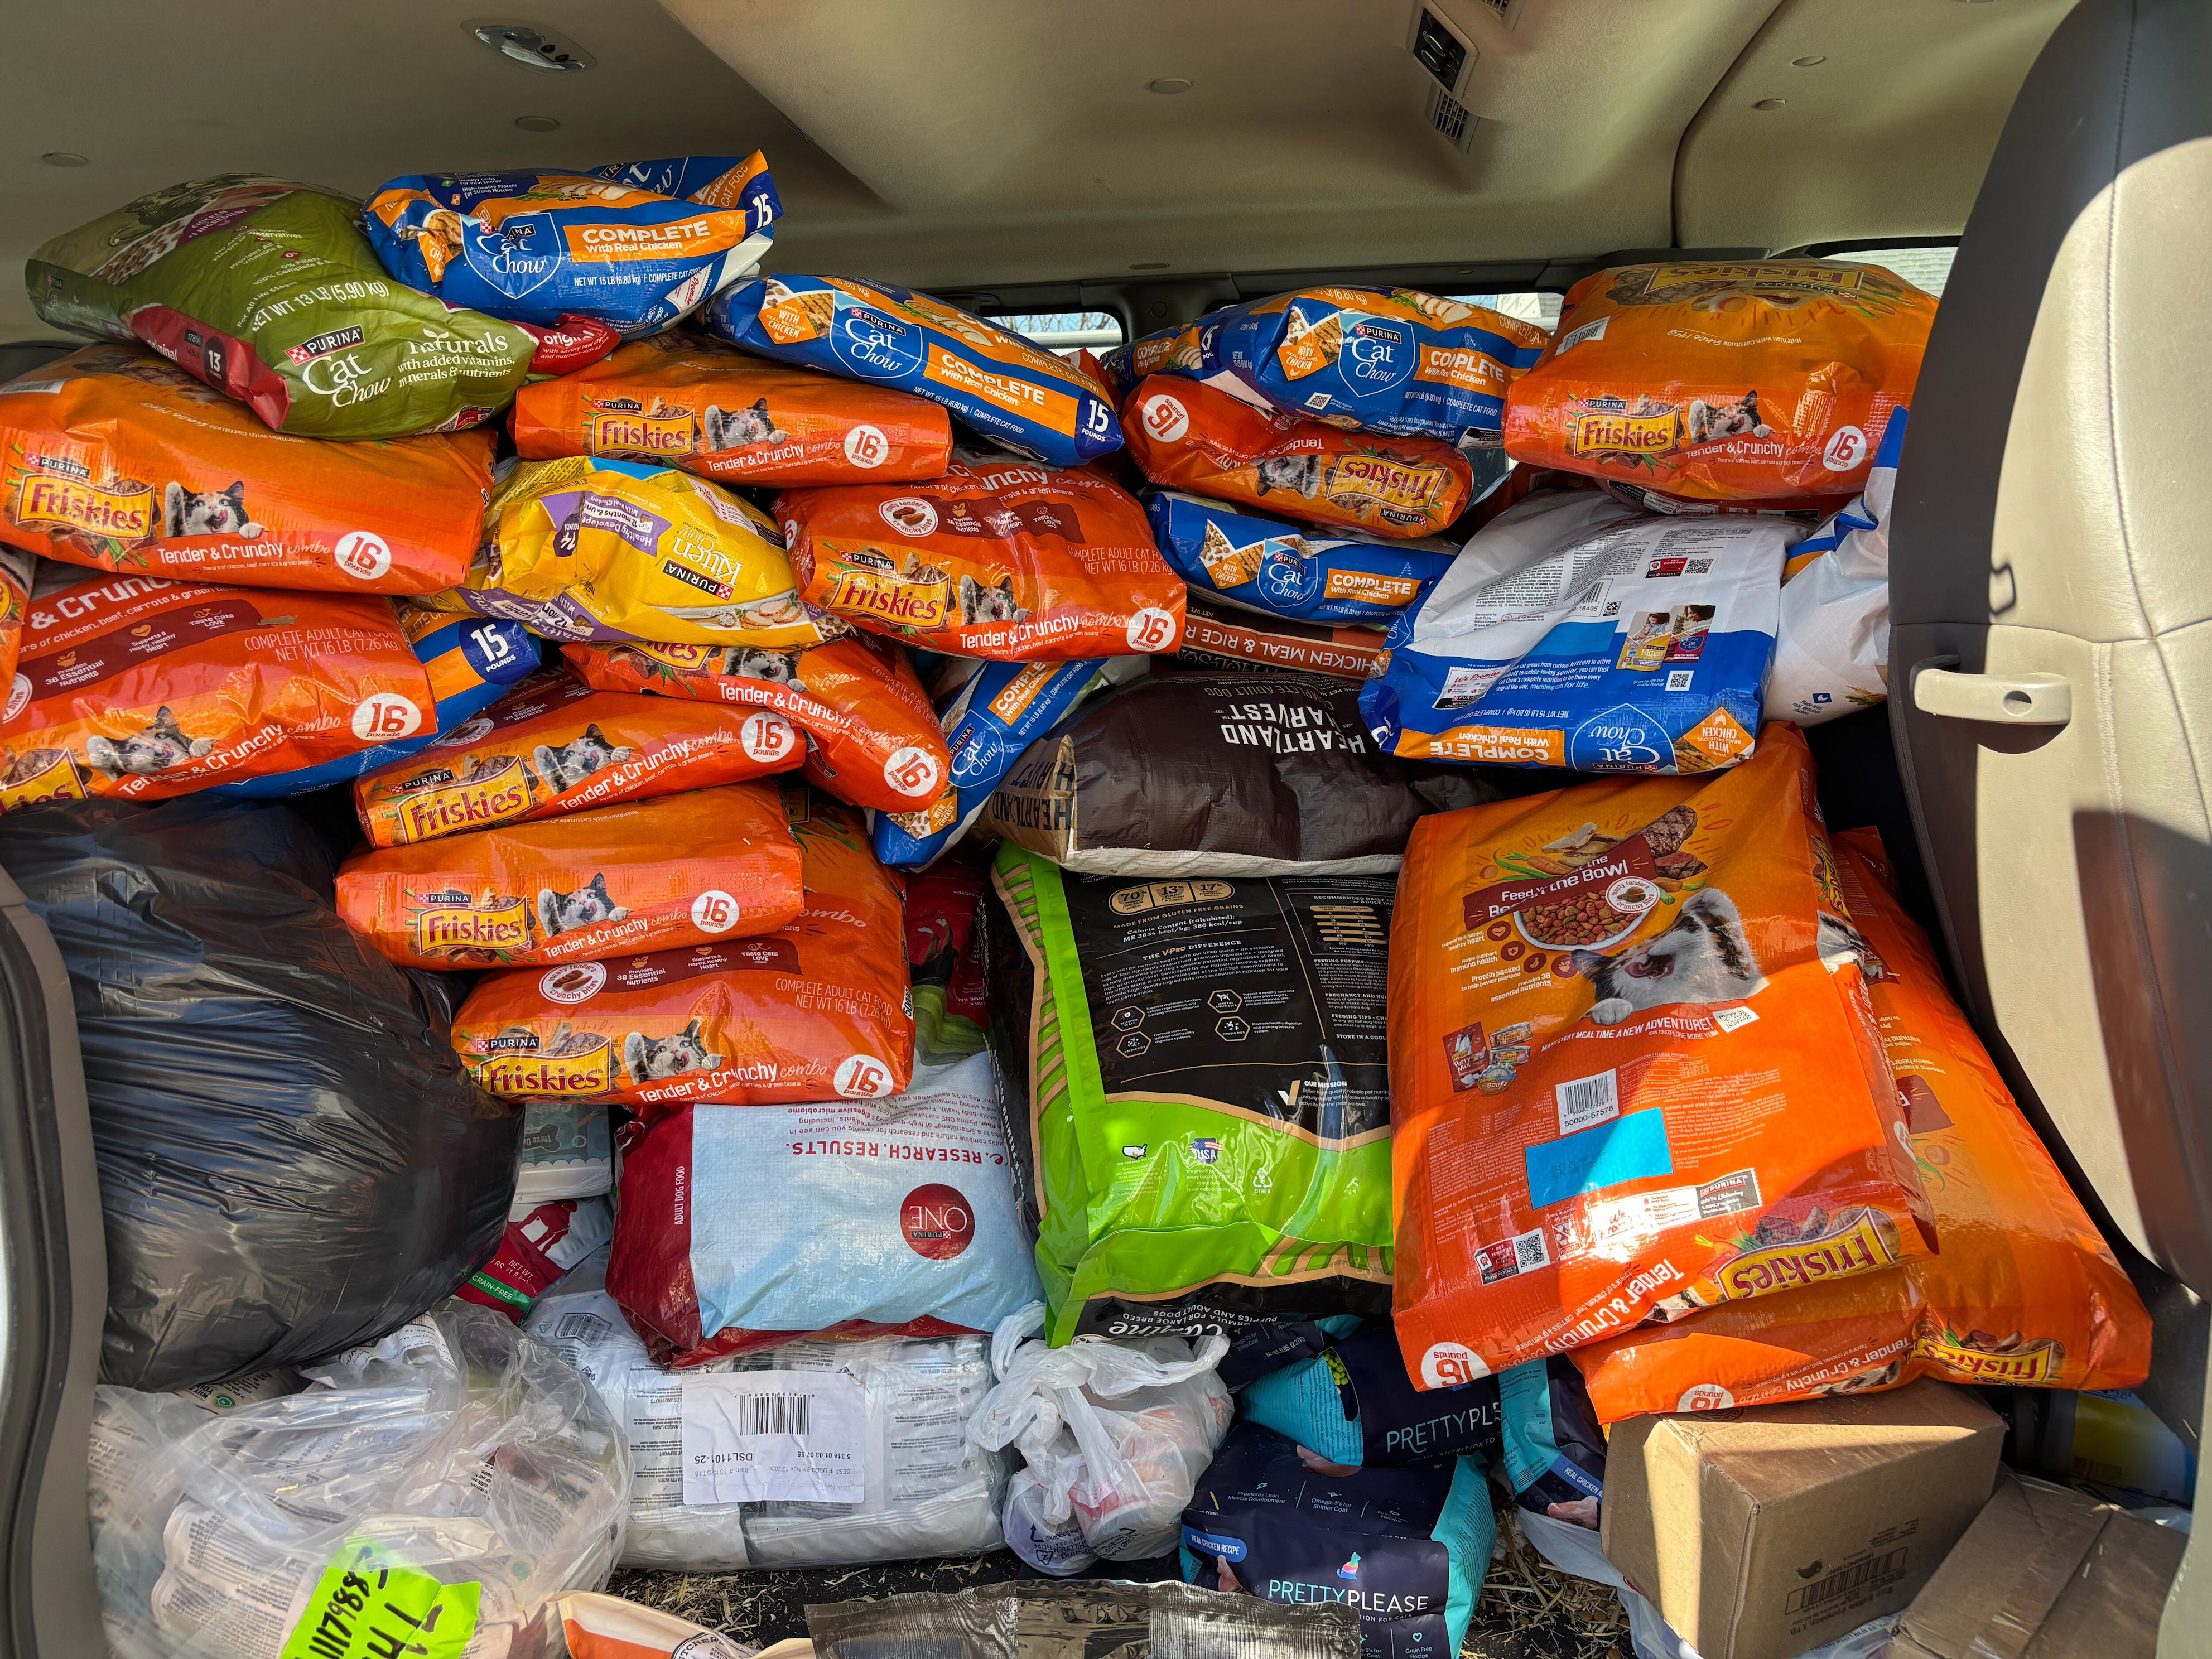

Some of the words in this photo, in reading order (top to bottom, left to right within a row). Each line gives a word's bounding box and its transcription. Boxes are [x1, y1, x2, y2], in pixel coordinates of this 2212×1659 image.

[191, 210, 228, 229] CHICKEN
[196, 209, 248, 233] INGREDIENT
[753, 195, 772, 228] 15
[582, 221, 710, 244] COMPLETE
[585, 244, 614, 254] With
[615, 242, 640, 252] Real
[641, 241, 682, 250] Chicken
[574, 278, 586, 286] NET
[616, 276, 632, 286] (6.80
[632, 275, 642, 286] kg)
[649, 272, 678, 283] COMPLETE
[678, 270, 687, 279] CAT
[1668, 266, 1844, 284] Friskies
[252, 308, 272, 333] NET
[272, 301, 296, 316] WT
[293, 293, 314, 307] 13
[314, 286, 331, 301] LB
[331, 282, 366, 303] (5.90
[369, 281, 389, 297] kg)
[862, 311, 905, 336] PURINA
[307, 329, 360, 355] PURINA
[844, 319, 897, 352] Cat
[1723, 338, 1755, 348] Cattitude
[1772, 336, 1801, 344] Nutrition
[208, 349, 221, 372] 13
[397, 358, 421, 373] with
[422, 354, 462, 368] added
[462, 355, 515, 366] vitamins,
[850, 343, 903, 372] Chow
[302, 352, 373, 397] Cat
[332, 377, 391, 408] Chow
[1087, 399, 1109, 431] 15
[601, 419, 690, 449] Friskies
[854, 430, 879, 459] 16
[1081, 428, 1106, 443] POUNDS
[1582, 419, 1671, 448] Friskies
[707, 456, 745, 474] Tender
[747, 452, 756, 466] &
[756, 442, 805, 468] Crunchy
[806, 437, 841, 455] combo
[1838, 431, 1858, 460] 16
[40, 457, 89, 478] PURINA
[850, 454, 875, 467] pounds
[1341, 460, 1445, 506] Friskies
[31, 485, 147, 531] Friskies
[158, 547, 209, 564] Tender
[210, 547, 221, 559] &
[221, 540, 283, 561] Crunchy
[287, 539, 331, 554] combo
[349, 536, 381, 568] 16
[673, 536, 744, 587] Kitten
[668, 562, 717, 592] PURINA
[1343, 574, 1412, 595] COMPLETE
[842, 581, 944, 619] Friskies
[1331, 586, 1346, 595] With
[1347, 588, 1361, 596] Real
[1361, 589, 1390, 600] Chicken
[470, 623, 509, 660] 15
[1200, 629, 1239, 649] RICE
[1243, 638, 1255, 653] &
[1260, 642, 1306, 660] MEAL
[1310, 650, 1376, 672] HICKEN
[485, 653, 517, 674] POUNDS
[1203, 687, 1232, 697] DOG
[1236, 685, 1274, 697] ADULT
[1530, 682, 1555, 691] nourishing
[1575, 681, 1589, 689] life.
[369, 701, 407, 732] 16
[718, 682, 773, 707] Tender
[773, 691, 786, 707] &
[787, 693, 853, 730] Crunchy
[1228, 704, 1341, 727] HARVEST
[755, 718, 783, 749] 16
[1220, 724, 1366, 754] HEARTLAND
[1458, 732, 1497, 742] Chicken
[1500, 735, 1520, 744] Real
[1530, 737, 1549, 747] With
[1430, 741, 1549, 761] COMPLETE
[411, 785, 525, 833] Friskies
[1582, 859, 1628, 882] Bowl
[703, 896, 730, 923] 16
[1138, 915, 1160, 924] FROM
[1162, 908, 1192, 919] GLUTEN
[428, 915, 523, 944] Friskies
[543, 939, 585, 958] Tender
[585, 934, 596, 948] &
[596, 917, 648, 944] Crunchy
[650, 910, 688, 927] combo
[1127, 926, 1155, 935] Calorie
[1157, 920, 1187, 930] Content
[1188, 914, 1235, 925] (calculated):
[1188, 940, 1242, 951] DIFFERENCE
[1471, 971, 1495, 982] Protein
[1496, 964, 1521, 977] packed
[775, 978, 825, 996] COMPLETE
[825, 986, 855, 1001] ADULT
[856, 990, 872, 1003] CAT
[874, 995, 893, 1016] FOOD
[1491, 986, 1519, 1002] essential
[1520, 979, 1551, 992] nutrients
[795, 995, 813, 1007] NET
[814, 997, 832, 1010] WT
[833, 999, 844, 1012] 16
[845, 1001, 857, 1014] LB
[859, 1001, 880, 1021] (7.26
[490, 1037, 538, 1050] PURINA
[489, 1064, 601, 1093] Friskies
[1564, 1105, 1613, 1127] 50000-57578
[785, 1141, 879, 1156] RESULTS.
[884, 1144, 982, 1164] RESEARCH.
[675, 1166, 685, 1184] FOOD
[675, 1184, 685, 1197] DOG
[674, 1198, 684, 1225] ADULT
[909, 1205, 968, 1232] ONE
[1733, 1233, 1878, 1299] Friskies
[471, 1275, 513, 1300] GRAIN-FREE
[694, 1453, 753, 1464] DSL1101-25
[1311, 1498, 1343, 1507] Omega-3's
[1191, 1535, 1202, 1545] REAL
[1203, 1538, 1221, 1552] CHICKEN
[1221, 1544, 1240, 1555] RECIPE
[1268, 1579, 1429, 1613] PRETTYPLEASE
